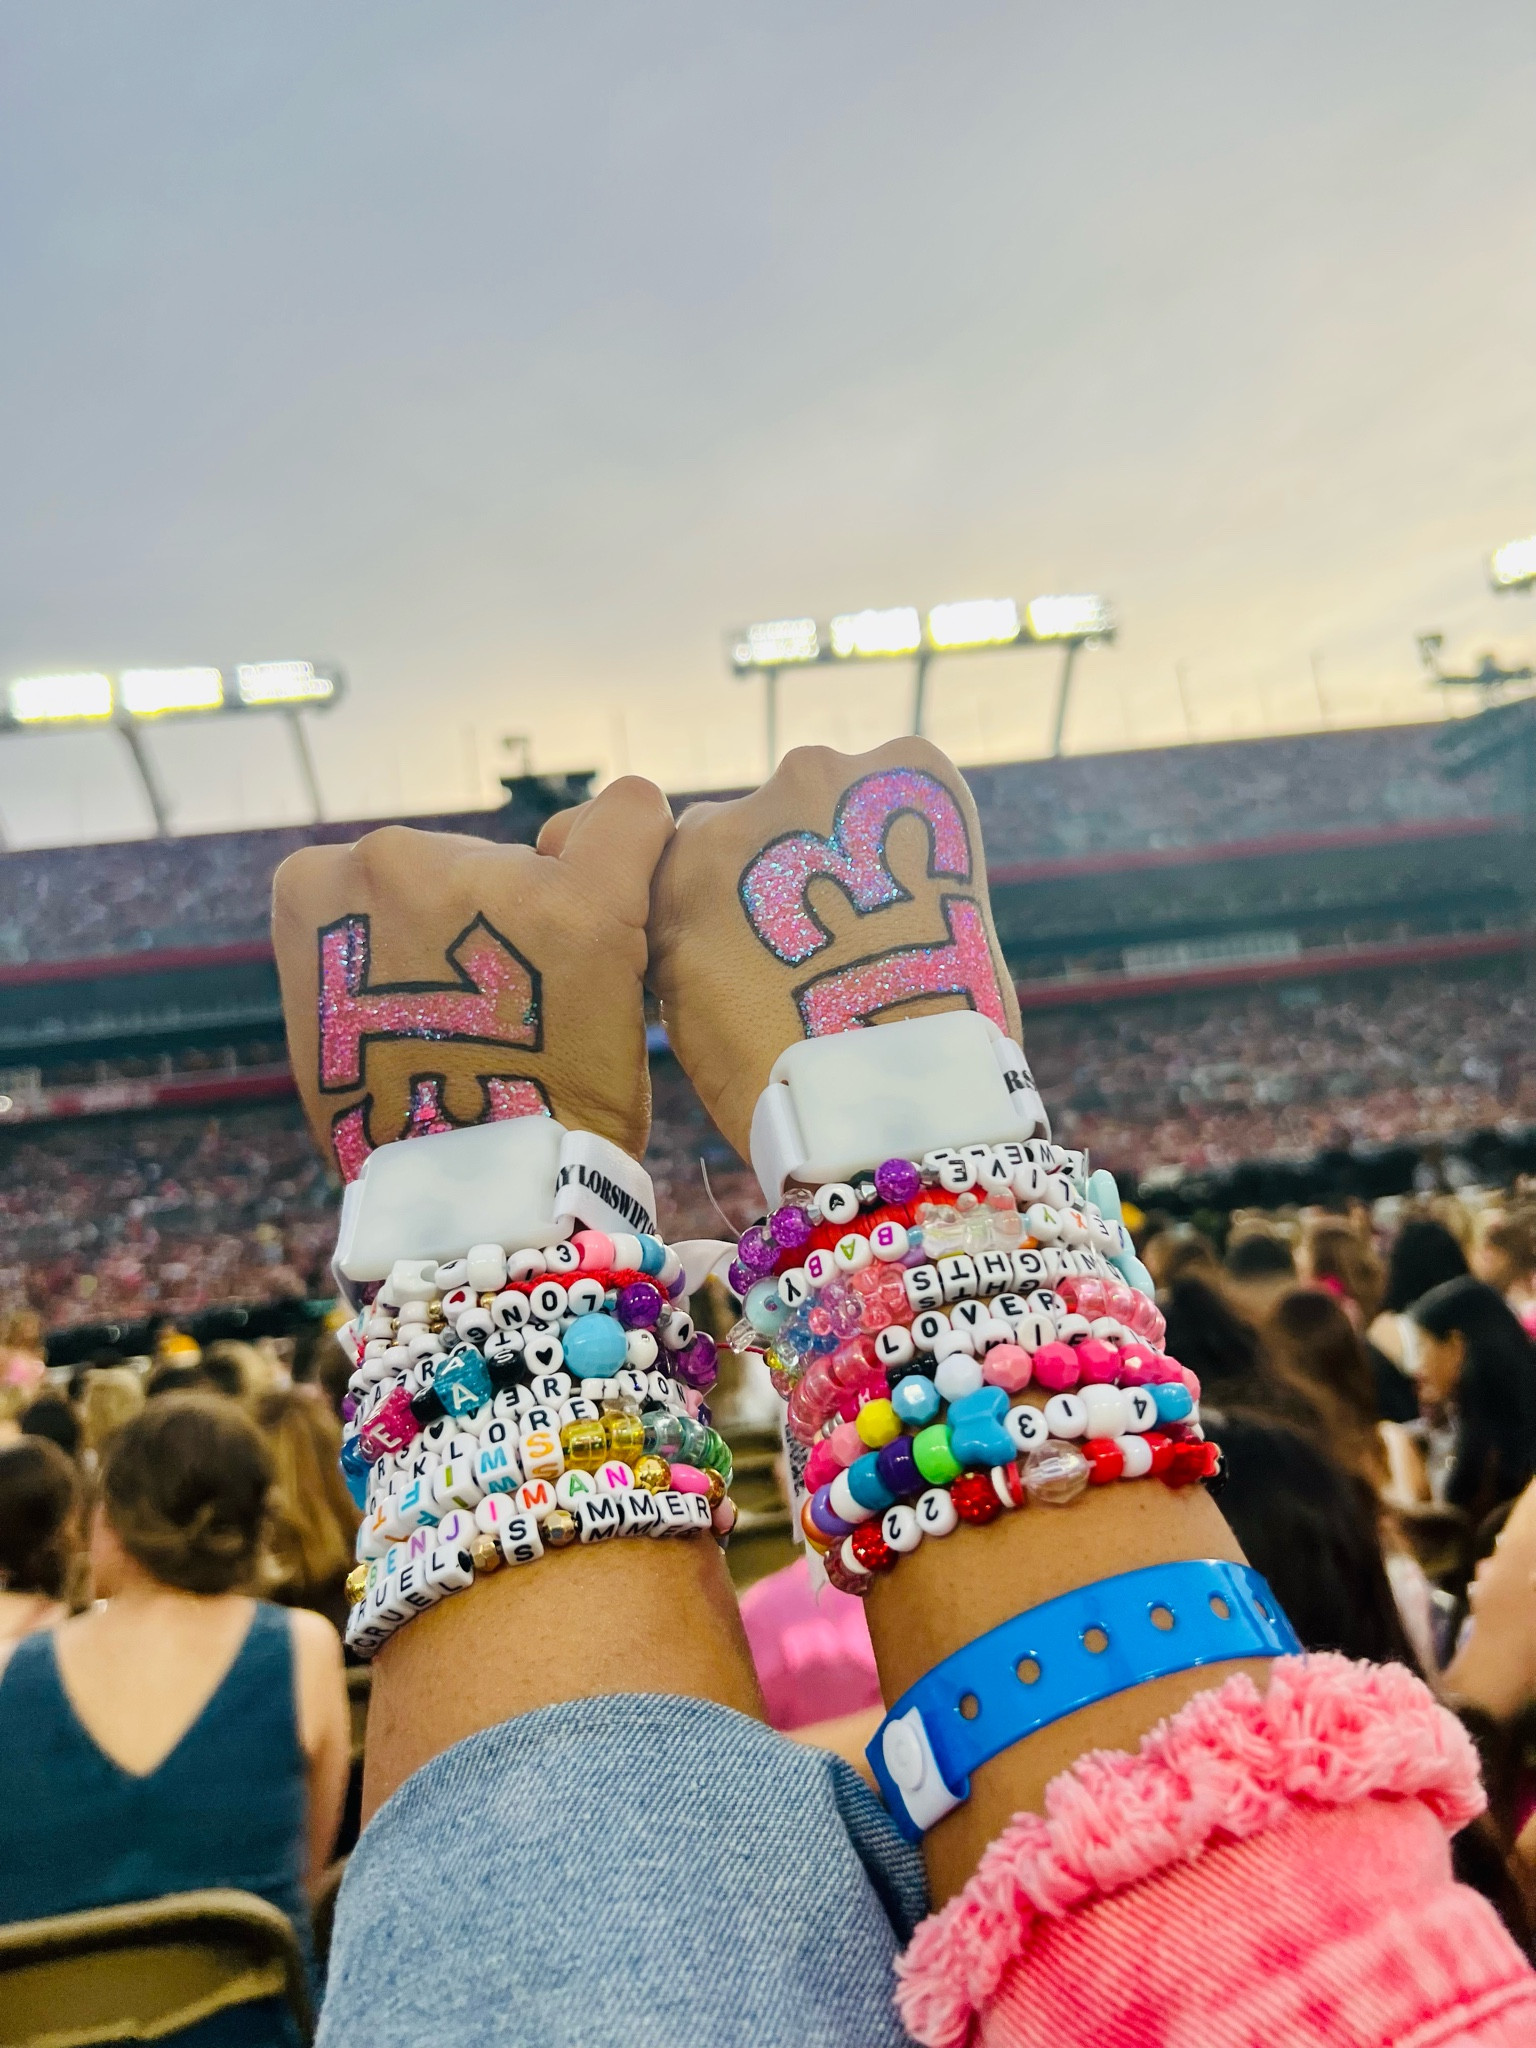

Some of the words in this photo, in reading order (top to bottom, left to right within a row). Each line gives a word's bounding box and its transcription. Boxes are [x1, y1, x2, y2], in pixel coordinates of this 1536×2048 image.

[738, 767, 1009, 1039] 13
[948, 1159, 1070, 1202] LIVE
[784, 1225, 894, 1302] BABY
[882, 1291, 1060, 1354] LOVER
[887, 1496, 939, 1540] 22
